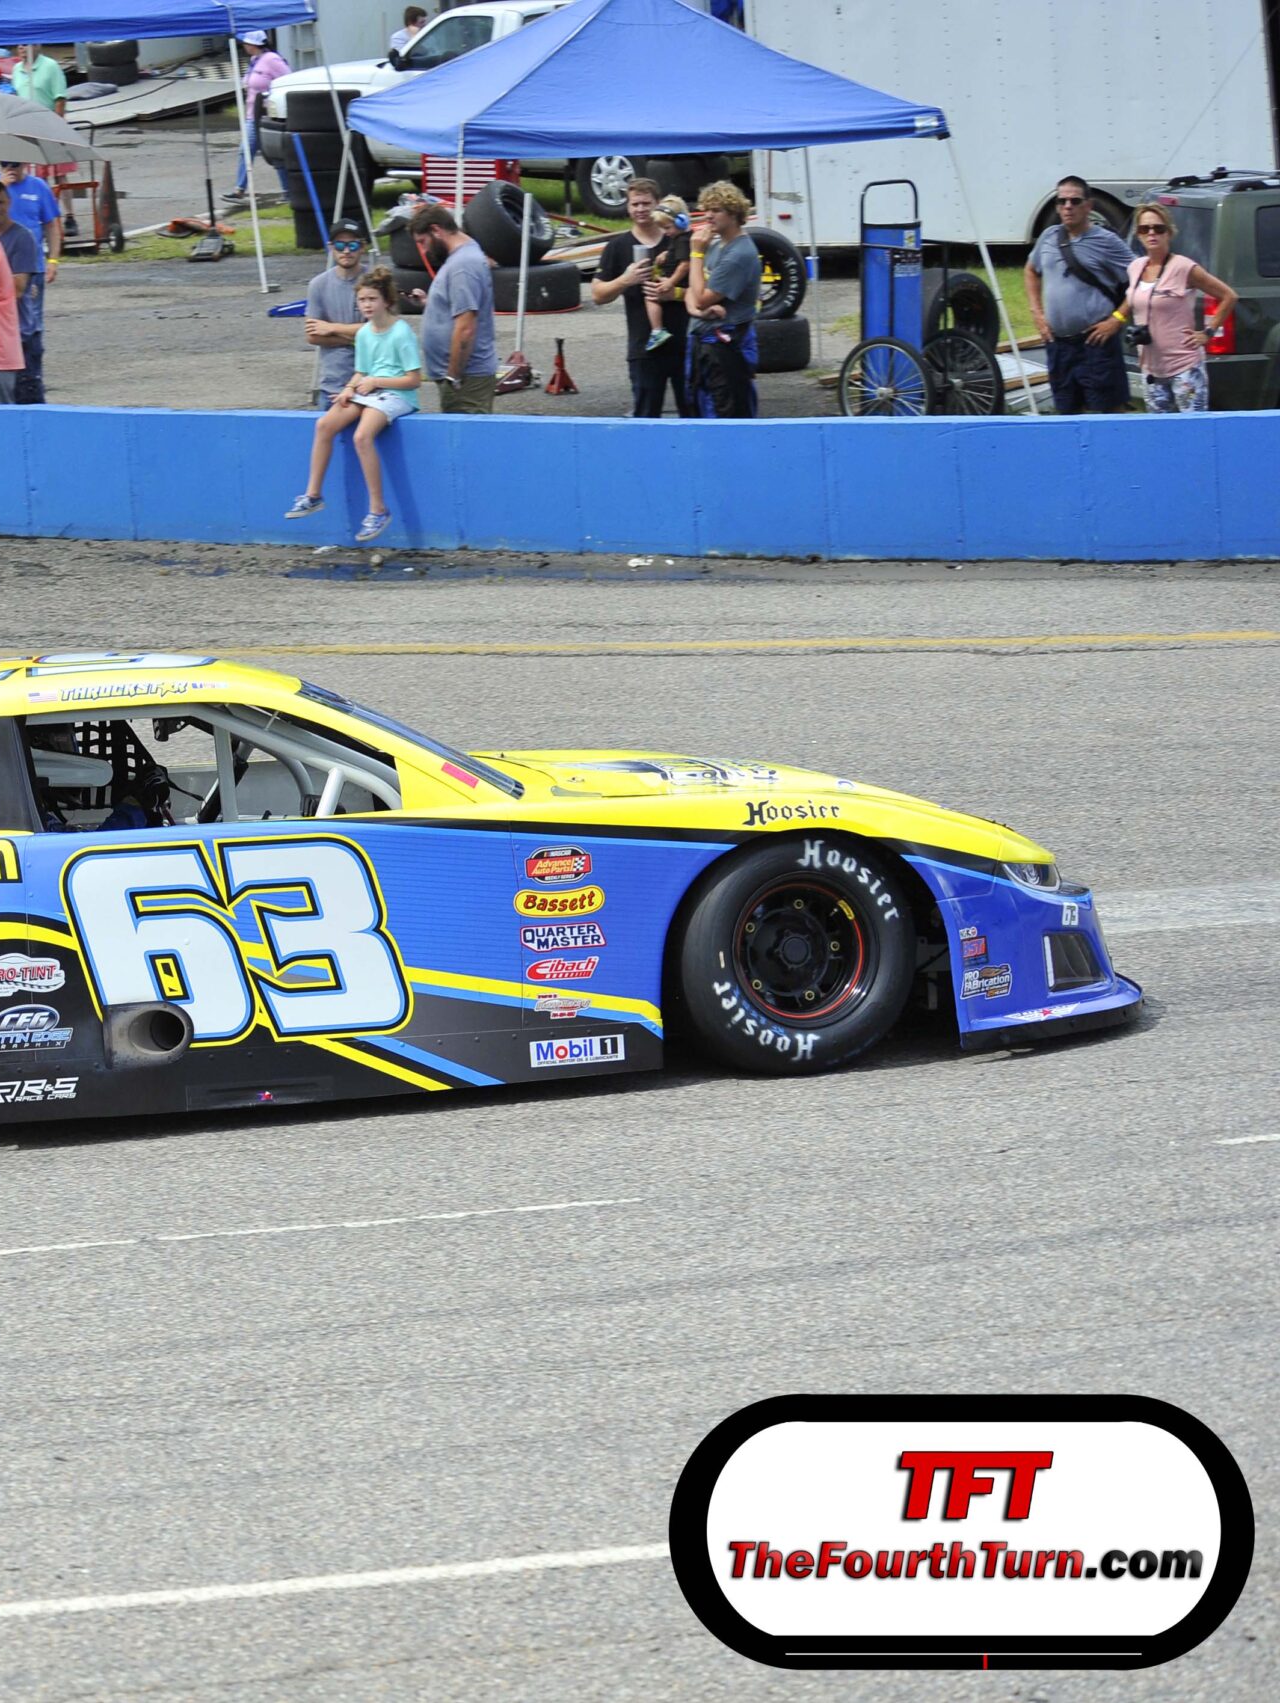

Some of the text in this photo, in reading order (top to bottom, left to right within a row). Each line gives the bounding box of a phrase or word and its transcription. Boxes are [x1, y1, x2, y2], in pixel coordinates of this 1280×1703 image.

[742, 799, 841, 827] Hoosier
[796, 838, 901, 922] Hoosier
[523, 890, 595, 912] Bassett
[60, 833, 414, 1048] 63
[523, 924, 597, 943] QUARTER
[537, 934, 602, 950] MASTER
[527, 957, 597, 979] Eibach
[713, 981, 821, 1061] Hoosier
[31, 1028, 71, 1043] EDGE
[536, 1038, 593, 1061] Mobil
